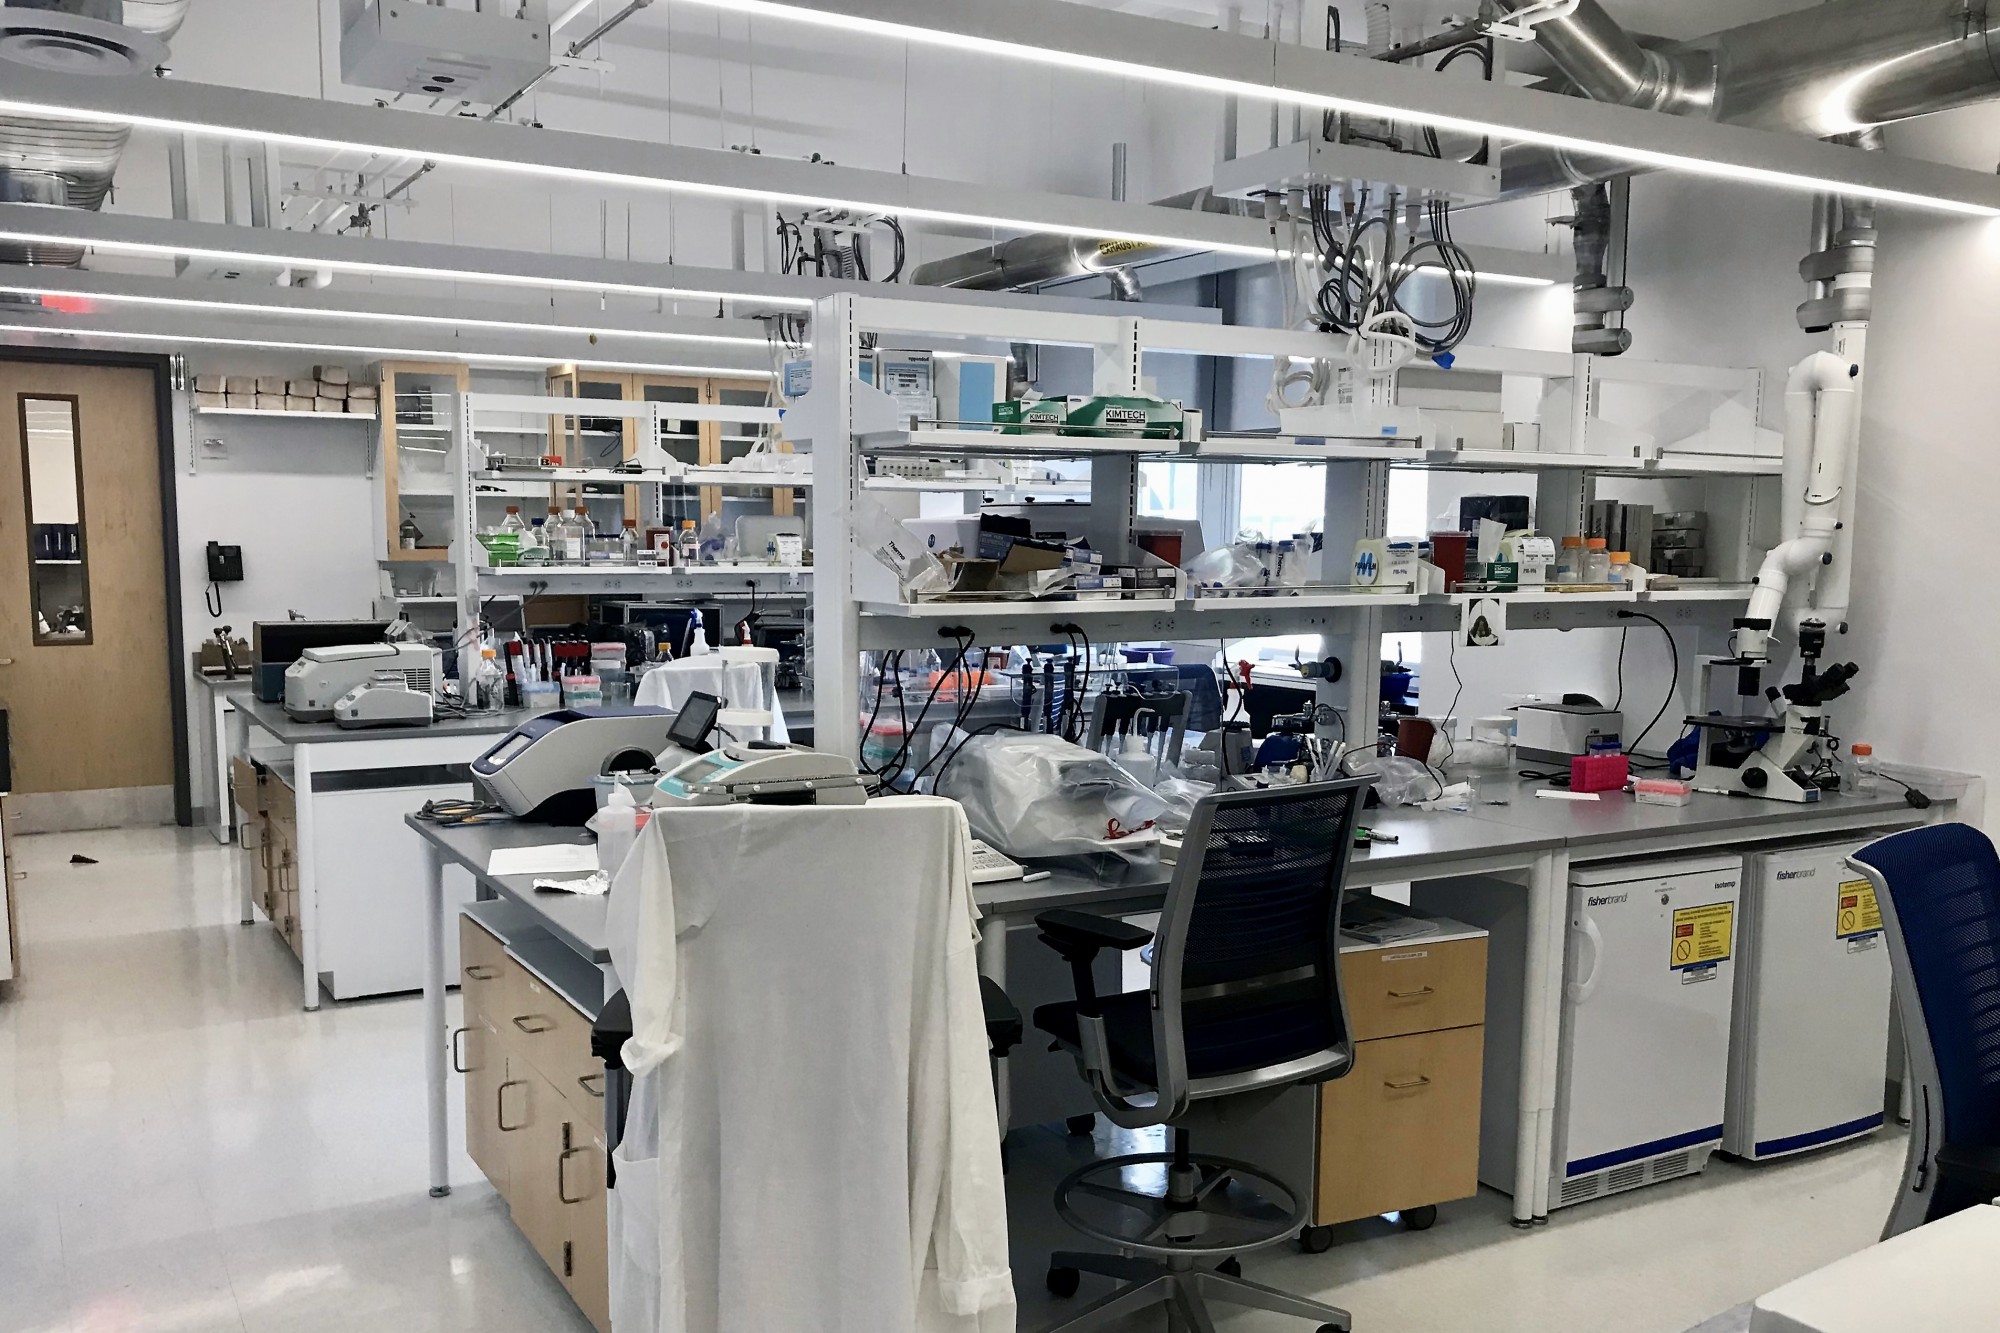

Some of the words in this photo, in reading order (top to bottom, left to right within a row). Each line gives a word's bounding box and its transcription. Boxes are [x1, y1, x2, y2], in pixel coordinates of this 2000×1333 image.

[1029, 413, 1059, 421] KIMTECH
[1105, 409, 1146, 419] KIMTECH
[888, 540, 906, 561] Thermo
[1776, 867, 1816, 880] fisherbrand
[1714, 880, 1736, 890] isotemp
[1587, 892, 1629, 907] fisherbrand
